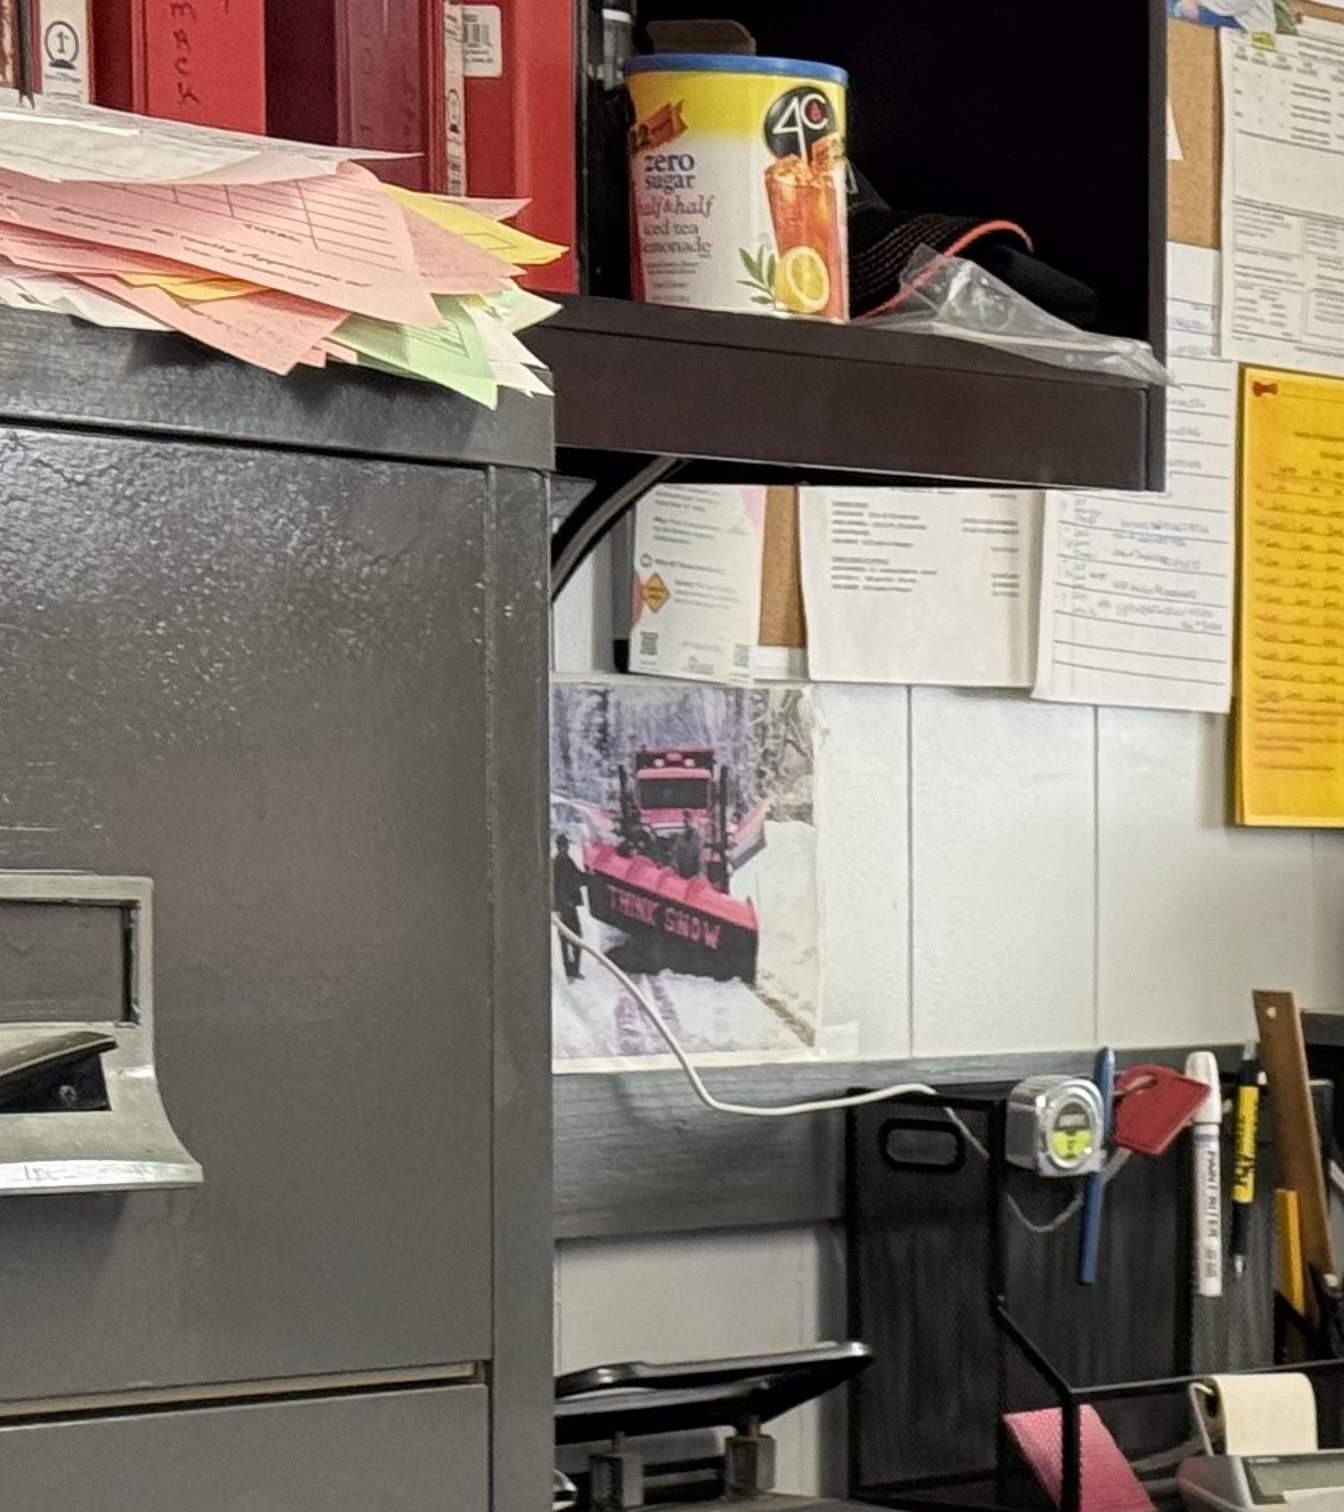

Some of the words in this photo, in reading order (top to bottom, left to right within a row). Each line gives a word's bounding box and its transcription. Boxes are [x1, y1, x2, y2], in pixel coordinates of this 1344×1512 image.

[644, 152, 696, 173] zero
[644, 174, 697, 195] sugar
[673, 222, 700, 236] tea
[643, 238, 713, 256] emonade
[607, 884, 661, 927] THINK
[664, 906, 722, 950] SNOW
